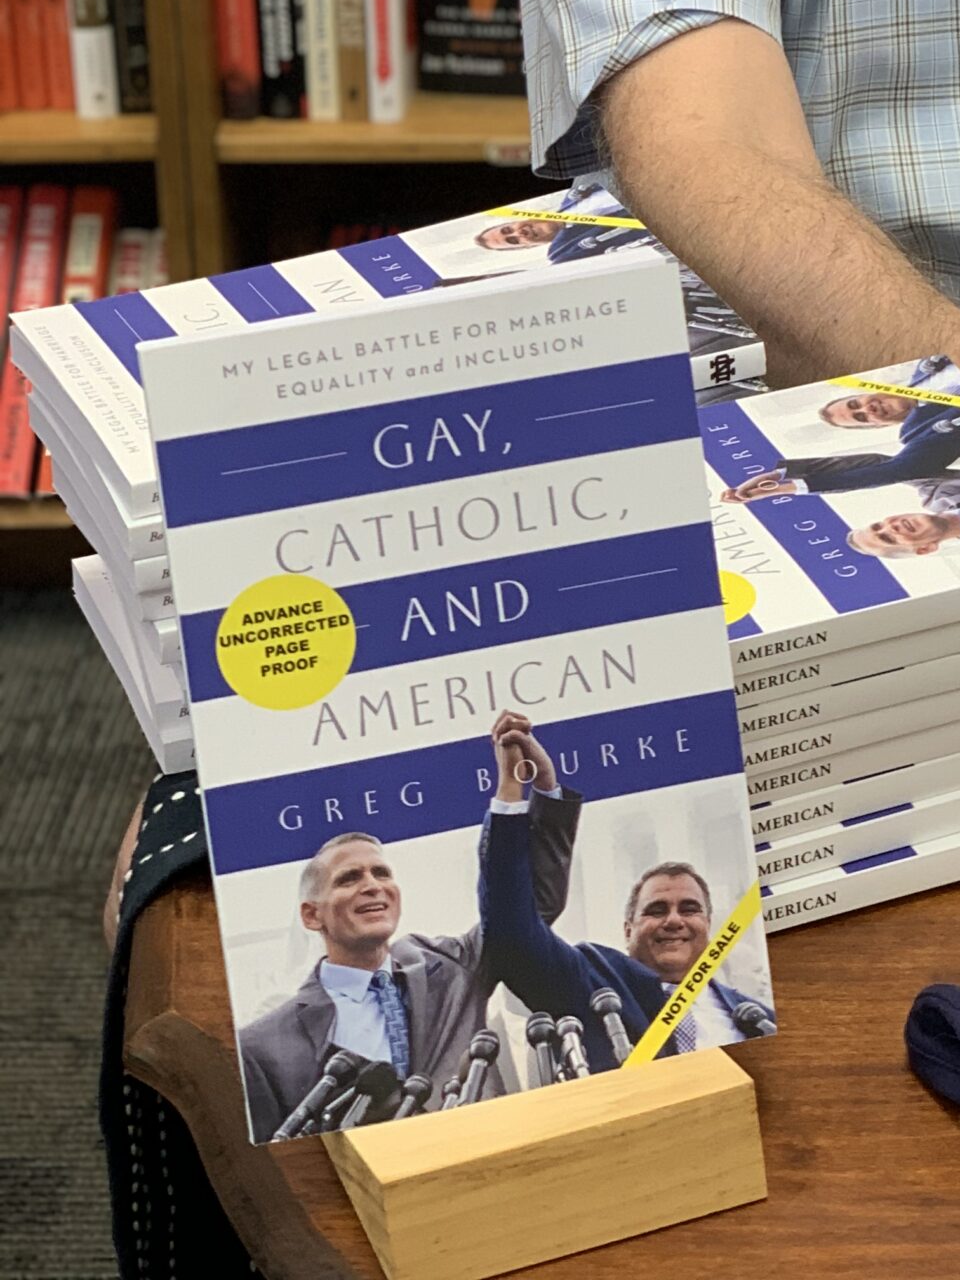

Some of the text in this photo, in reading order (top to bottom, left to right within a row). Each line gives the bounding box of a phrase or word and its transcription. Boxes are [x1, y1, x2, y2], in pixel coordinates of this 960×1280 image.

[512, 210, 597, 224] NOT FOR SALE
[222, 298, 629, 379] MY LEGAL BATTLE FOR MARRIAGE
[34, 325, 140, 455] MY LEGAL BATTLE FOR MARRIAGE
[69, 335, 149, 432] EQUALITY and INCLUSION
[276, 334, 586, 399] EQUALITY and INCLUSION
[858, 381, 953, 403] NOT FOR SALE
[372, 409, 513, 469] GAY,
[707, 422, 858, 578] GREG BOURKE
[275, 476, 629, 574] CATHOLIC,
[218, 614, 351, 648] UNCORRECTED
[241, 600, 324, 627] ADVANCE
[401, 578, 531, 642] AND
[260, 655, 319, 677] PROOF
[264, 640, 311, 658] PAGE
[736, 630, 828, 664] AMERICAN
[312, 645, 638, 746] AMERICAN
[741, 703, 821, 734] MERICAN
[743, 733, 833, 767] AMERICAN
[277, 728, 692, 832] GREG BOURKE
[757, 844, 835, 876] MERICAN
[762, 891, 837, 923] MERICAN
[660, 921, 741, 1026] NOT FOR SALE
